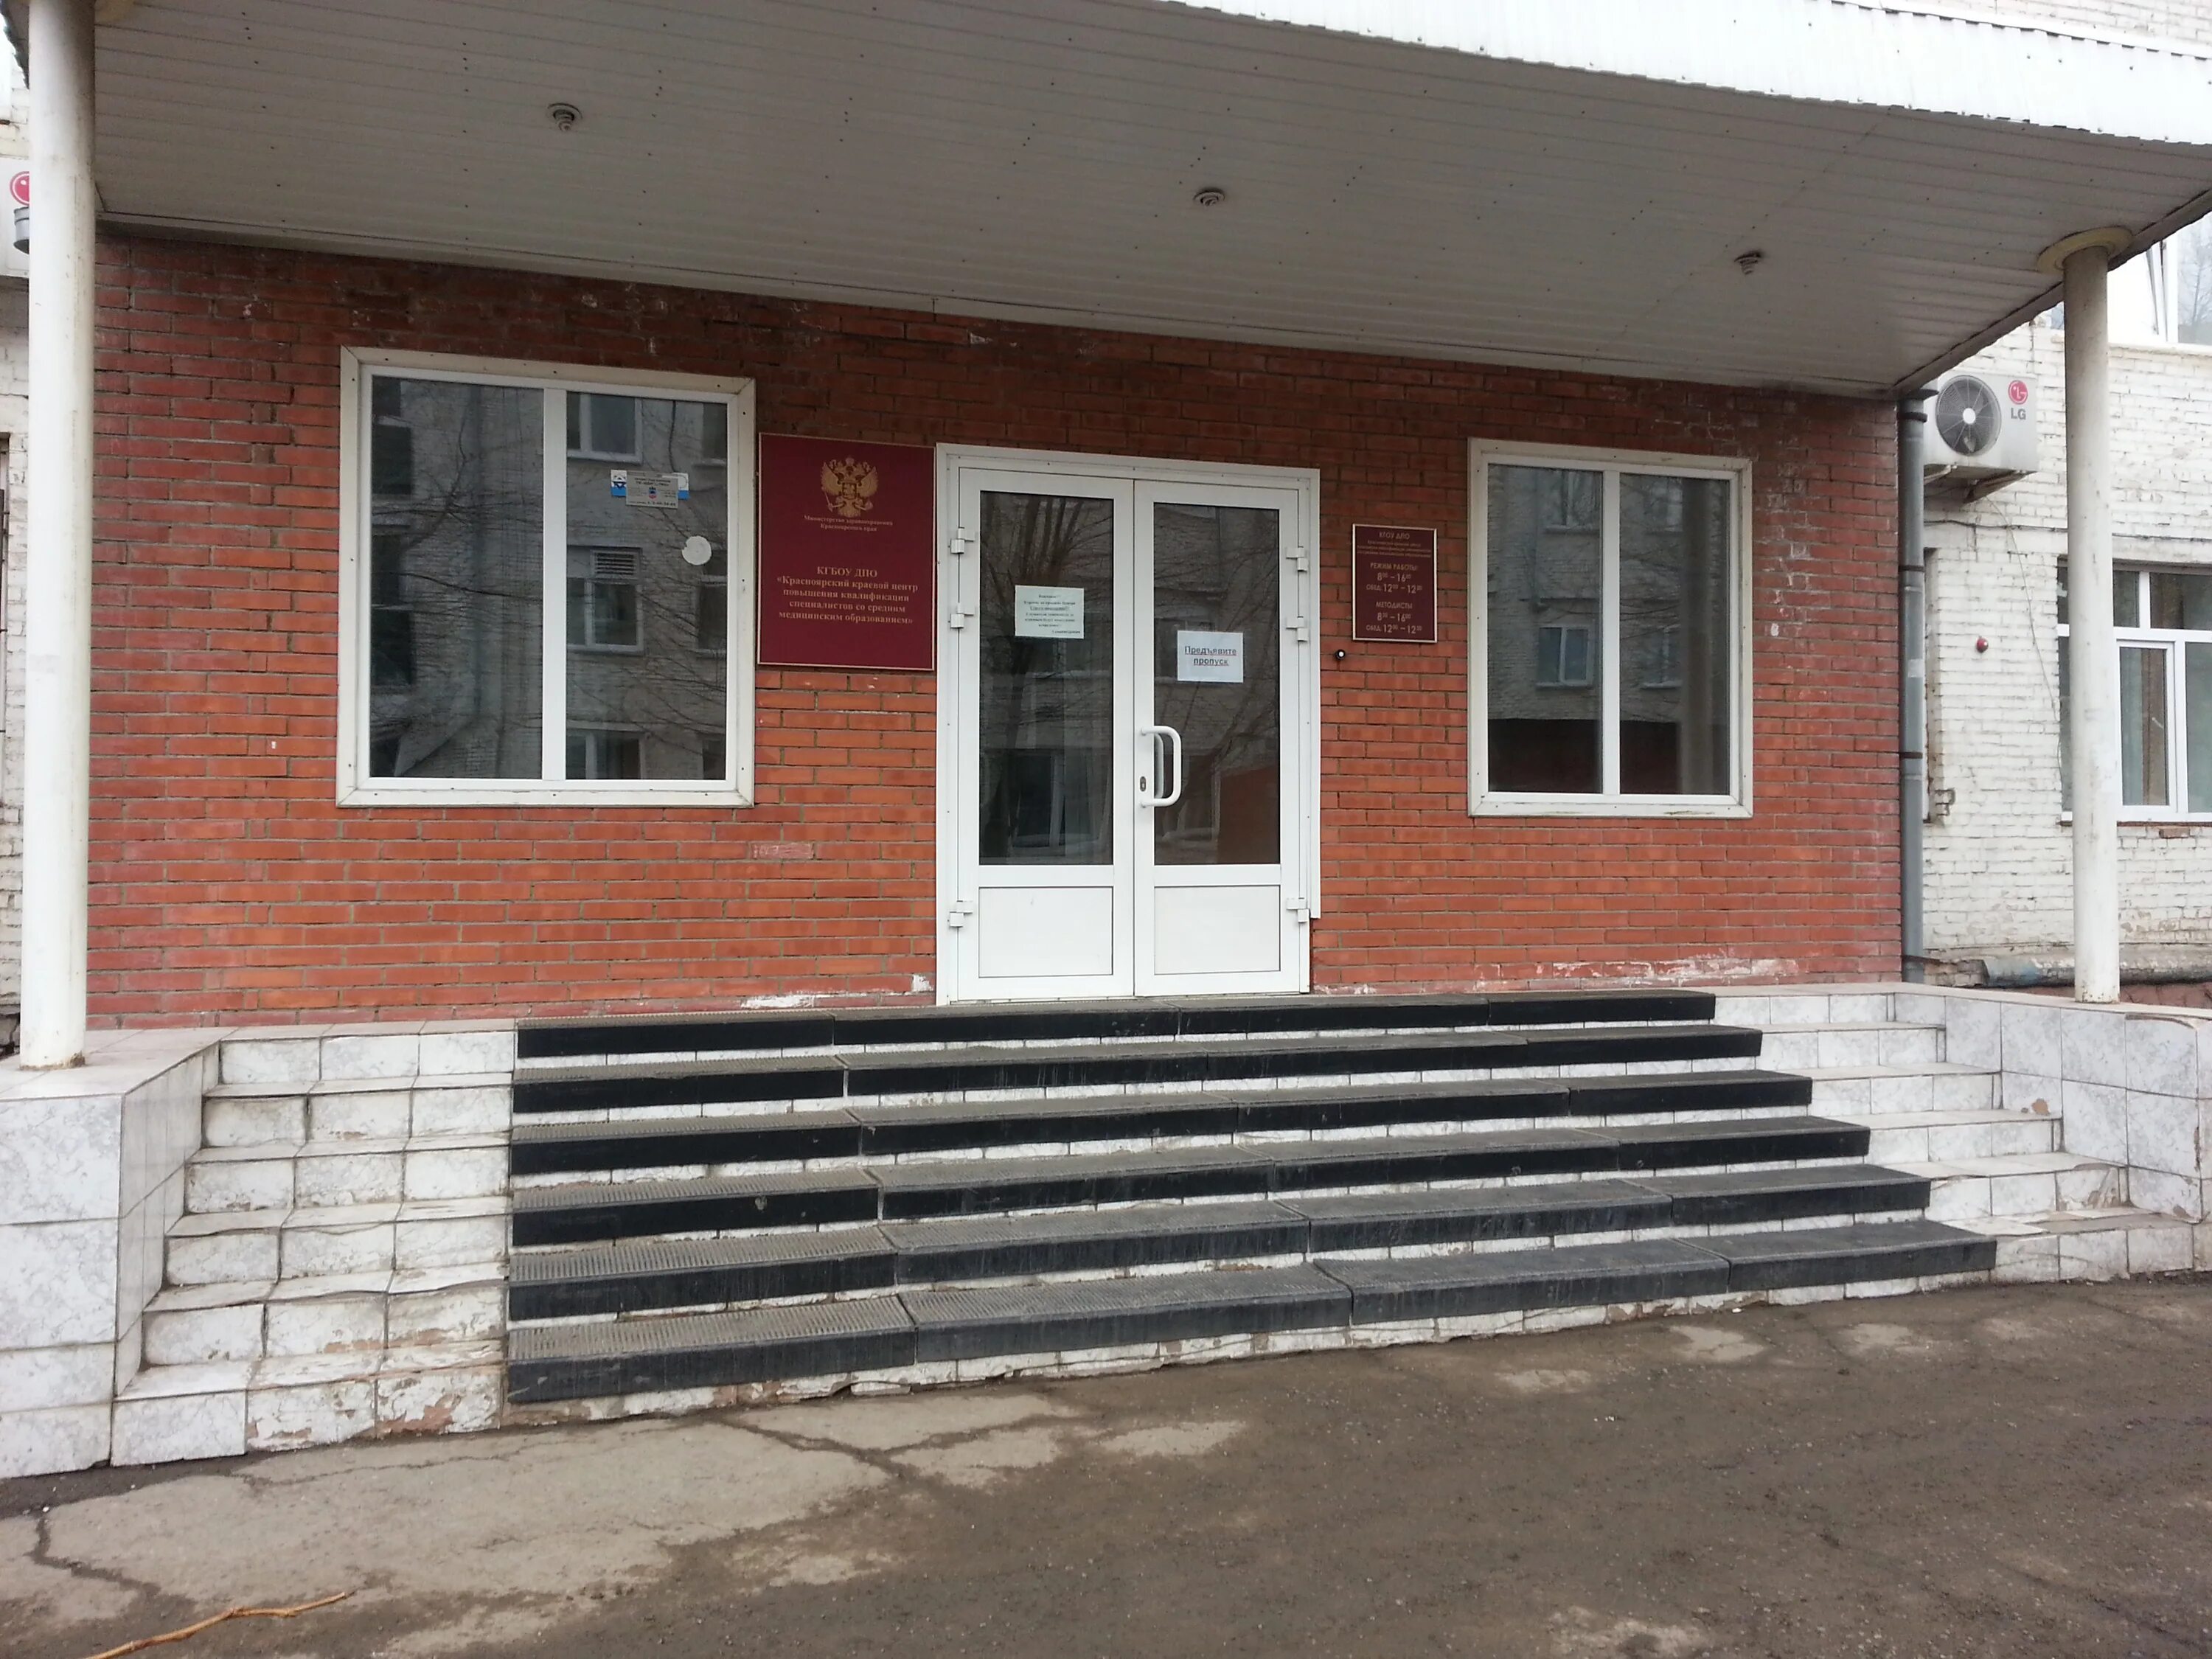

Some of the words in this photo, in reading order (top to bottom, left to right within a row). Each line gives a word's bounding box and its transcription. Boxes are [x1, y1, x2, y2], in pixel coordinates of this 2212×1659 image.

[2011, 408, 2026, 420] LG
[816, 566, 852, 577] КГБОУ
[855, 568, 878, 578] ДПО
[777, 575, 849, 588] «Красноярский
[852, 581, 889, 591] краевой
[891, 584, 919, 593] центр
[783, 588, 838, 598] повышения
[841, 592, 910, 602] квалификации
[789, 600, 854, 610] специалистов
[867, 605, 906, 613] средним
[779, 611, 843, 622] медицинским
[1185, 645, 1237, 655] Предъявите
[1194, 658, 1228, 667] пропуск
